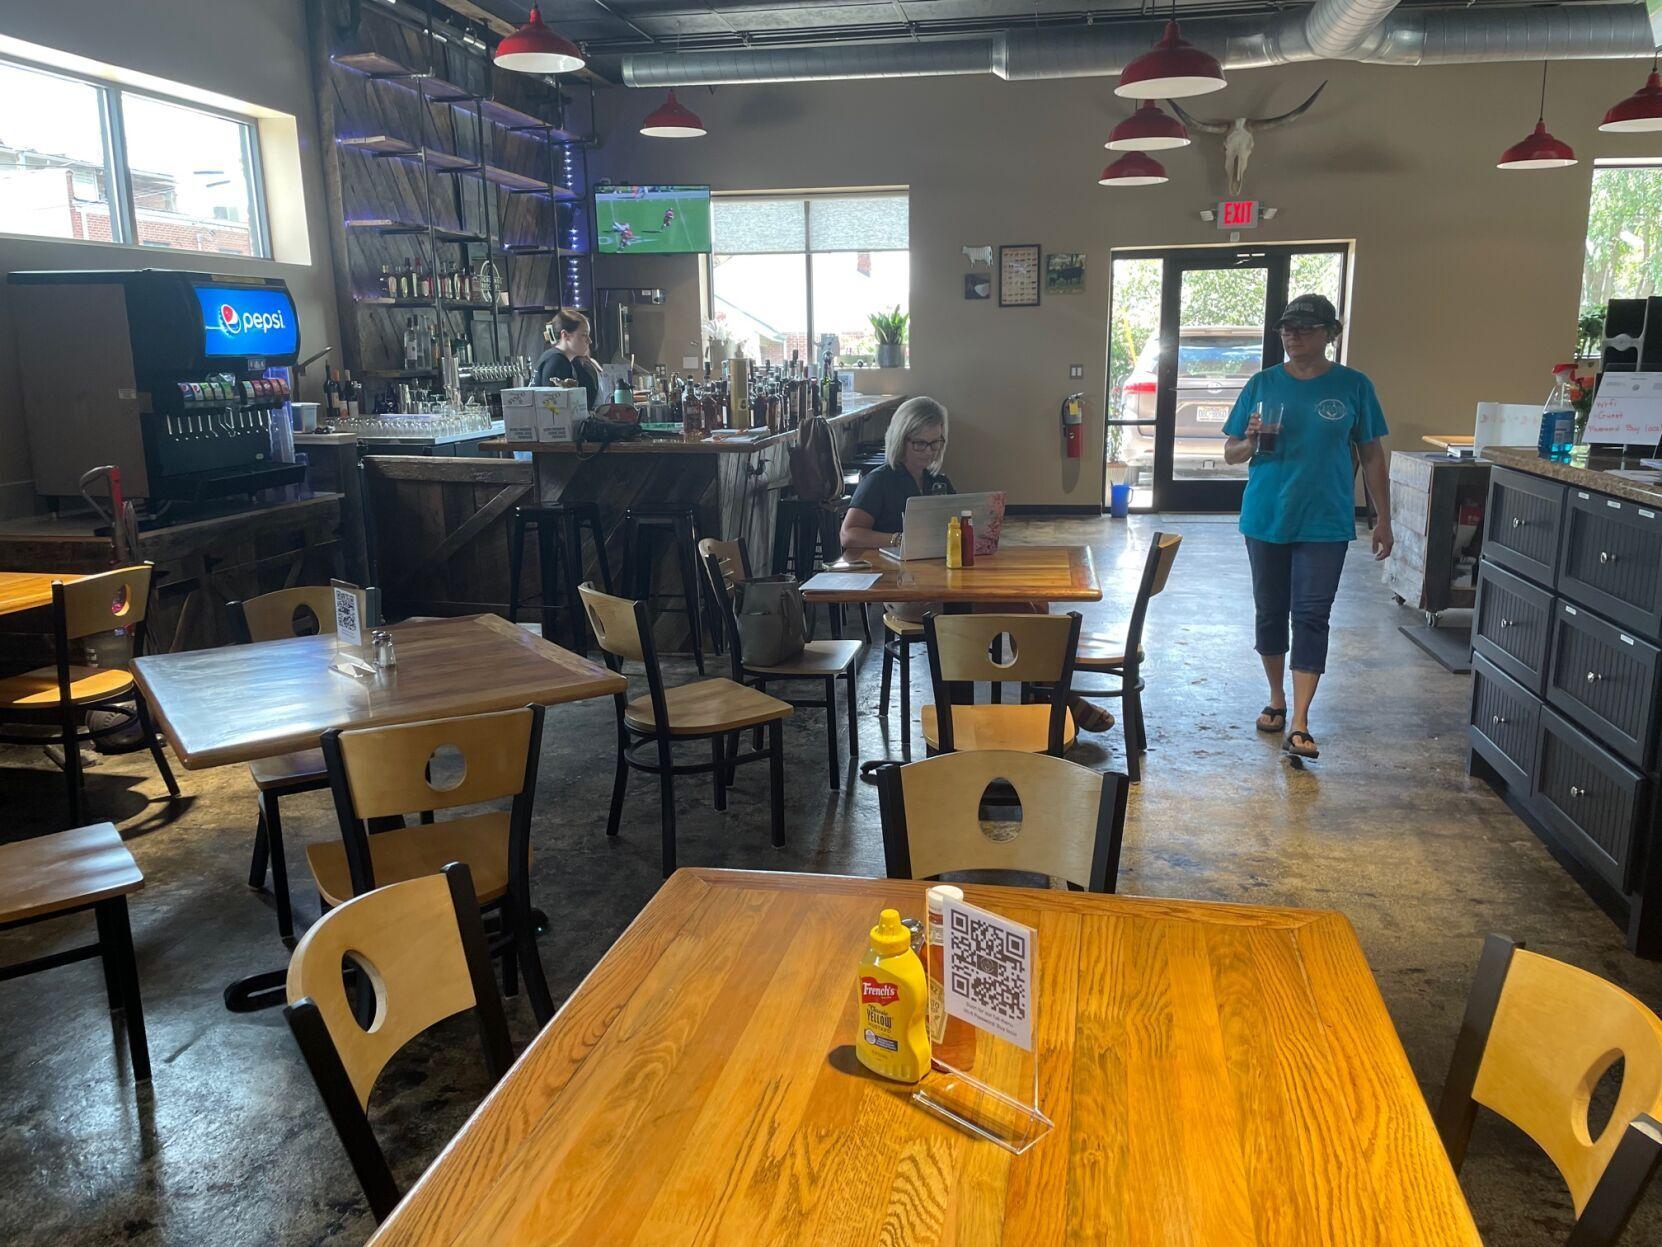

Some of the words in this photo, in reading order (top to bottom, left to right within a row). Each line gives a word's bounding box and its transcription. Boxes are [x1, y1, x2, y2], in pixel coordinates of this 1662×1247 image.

[1224, 202, 1253, 224] EXIT
[243, 309, 284, 334] pepsi
[862, 982, 895, 997] French's
[866, 1009, 892, 1029] YELLOW
